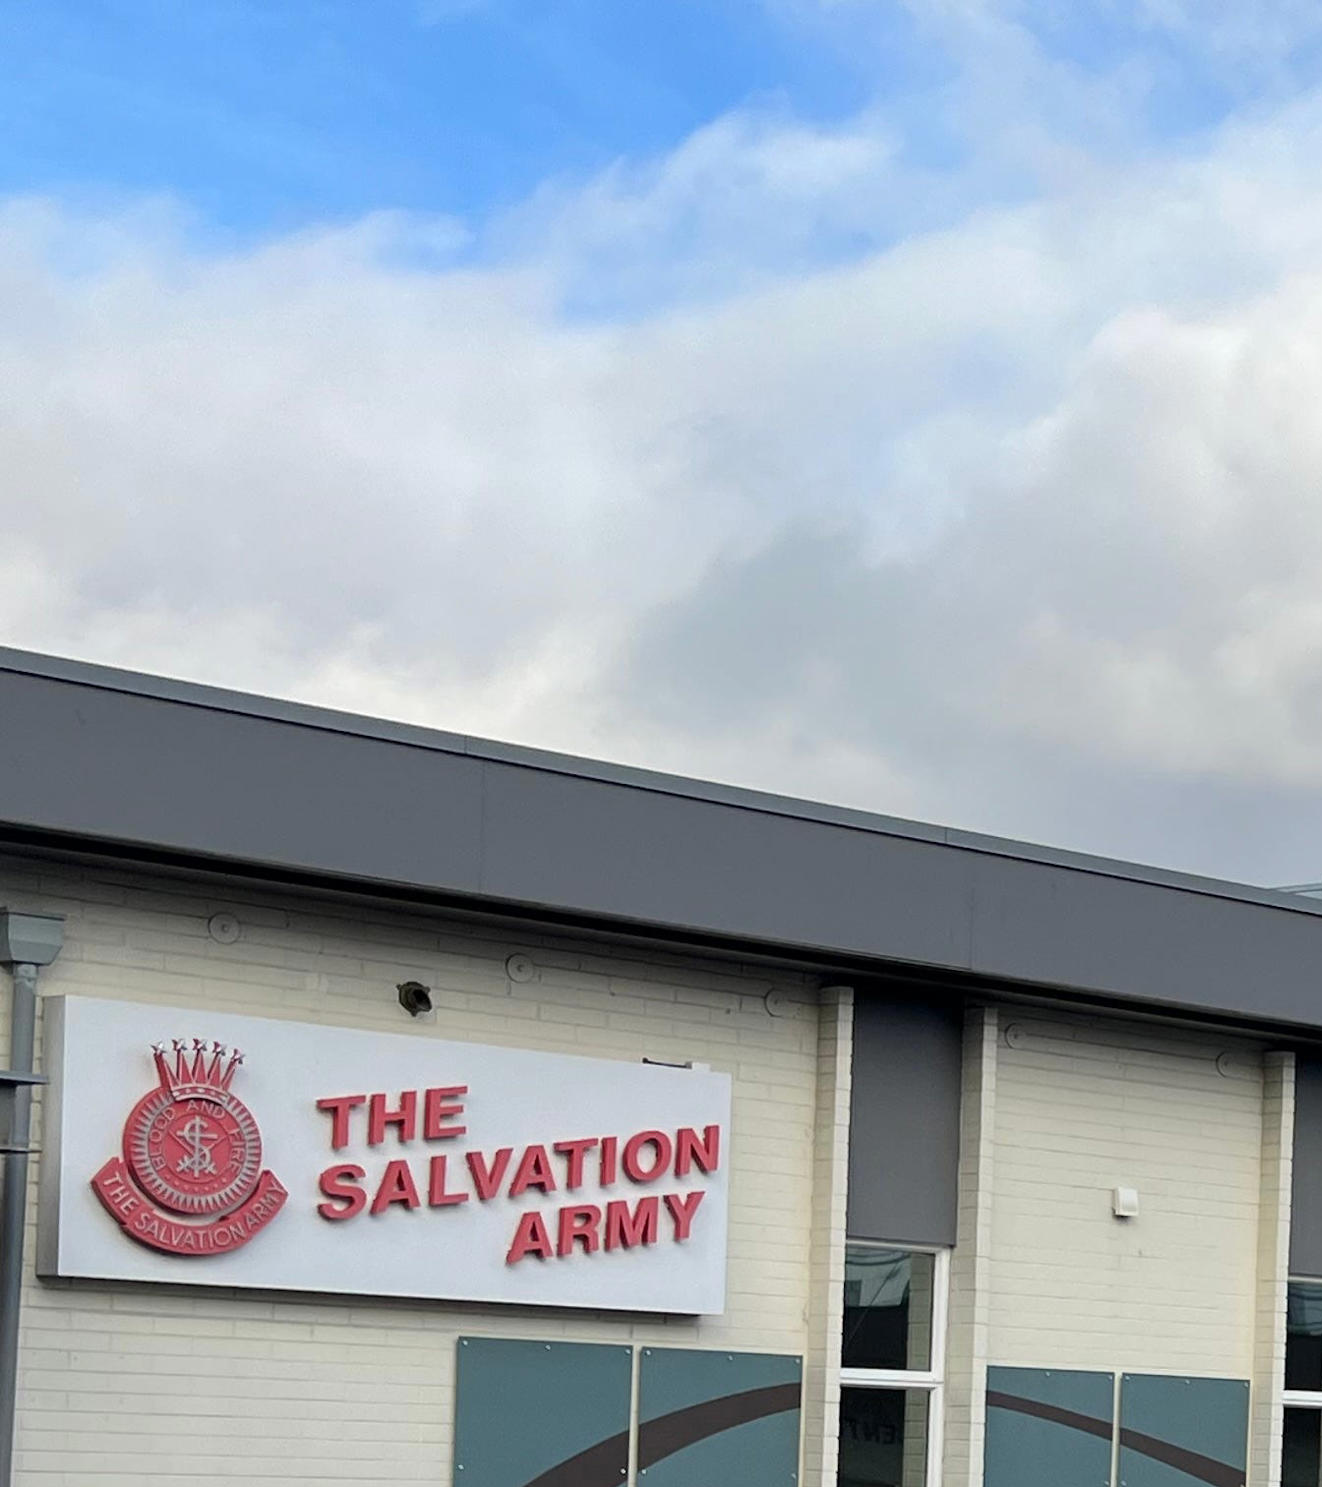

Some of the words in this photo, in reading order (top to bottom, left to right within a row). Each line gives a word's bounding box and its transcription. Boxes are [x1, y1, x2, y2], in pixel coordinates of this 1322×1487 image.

[149, 1106, 176, 1170] BLOOD
[186, 1100, 226, 1119] AND
[316, 1085, 468, 1150] THE
[103, 1171, 140, 1216] THE
[134, 1212, 248, 1250] SALVATION
[244, 1181, 285, 1229] ARMY
[317, 1124, 721, 1221] SALVATION
[506, 1190, 706, 1266] ARMY
